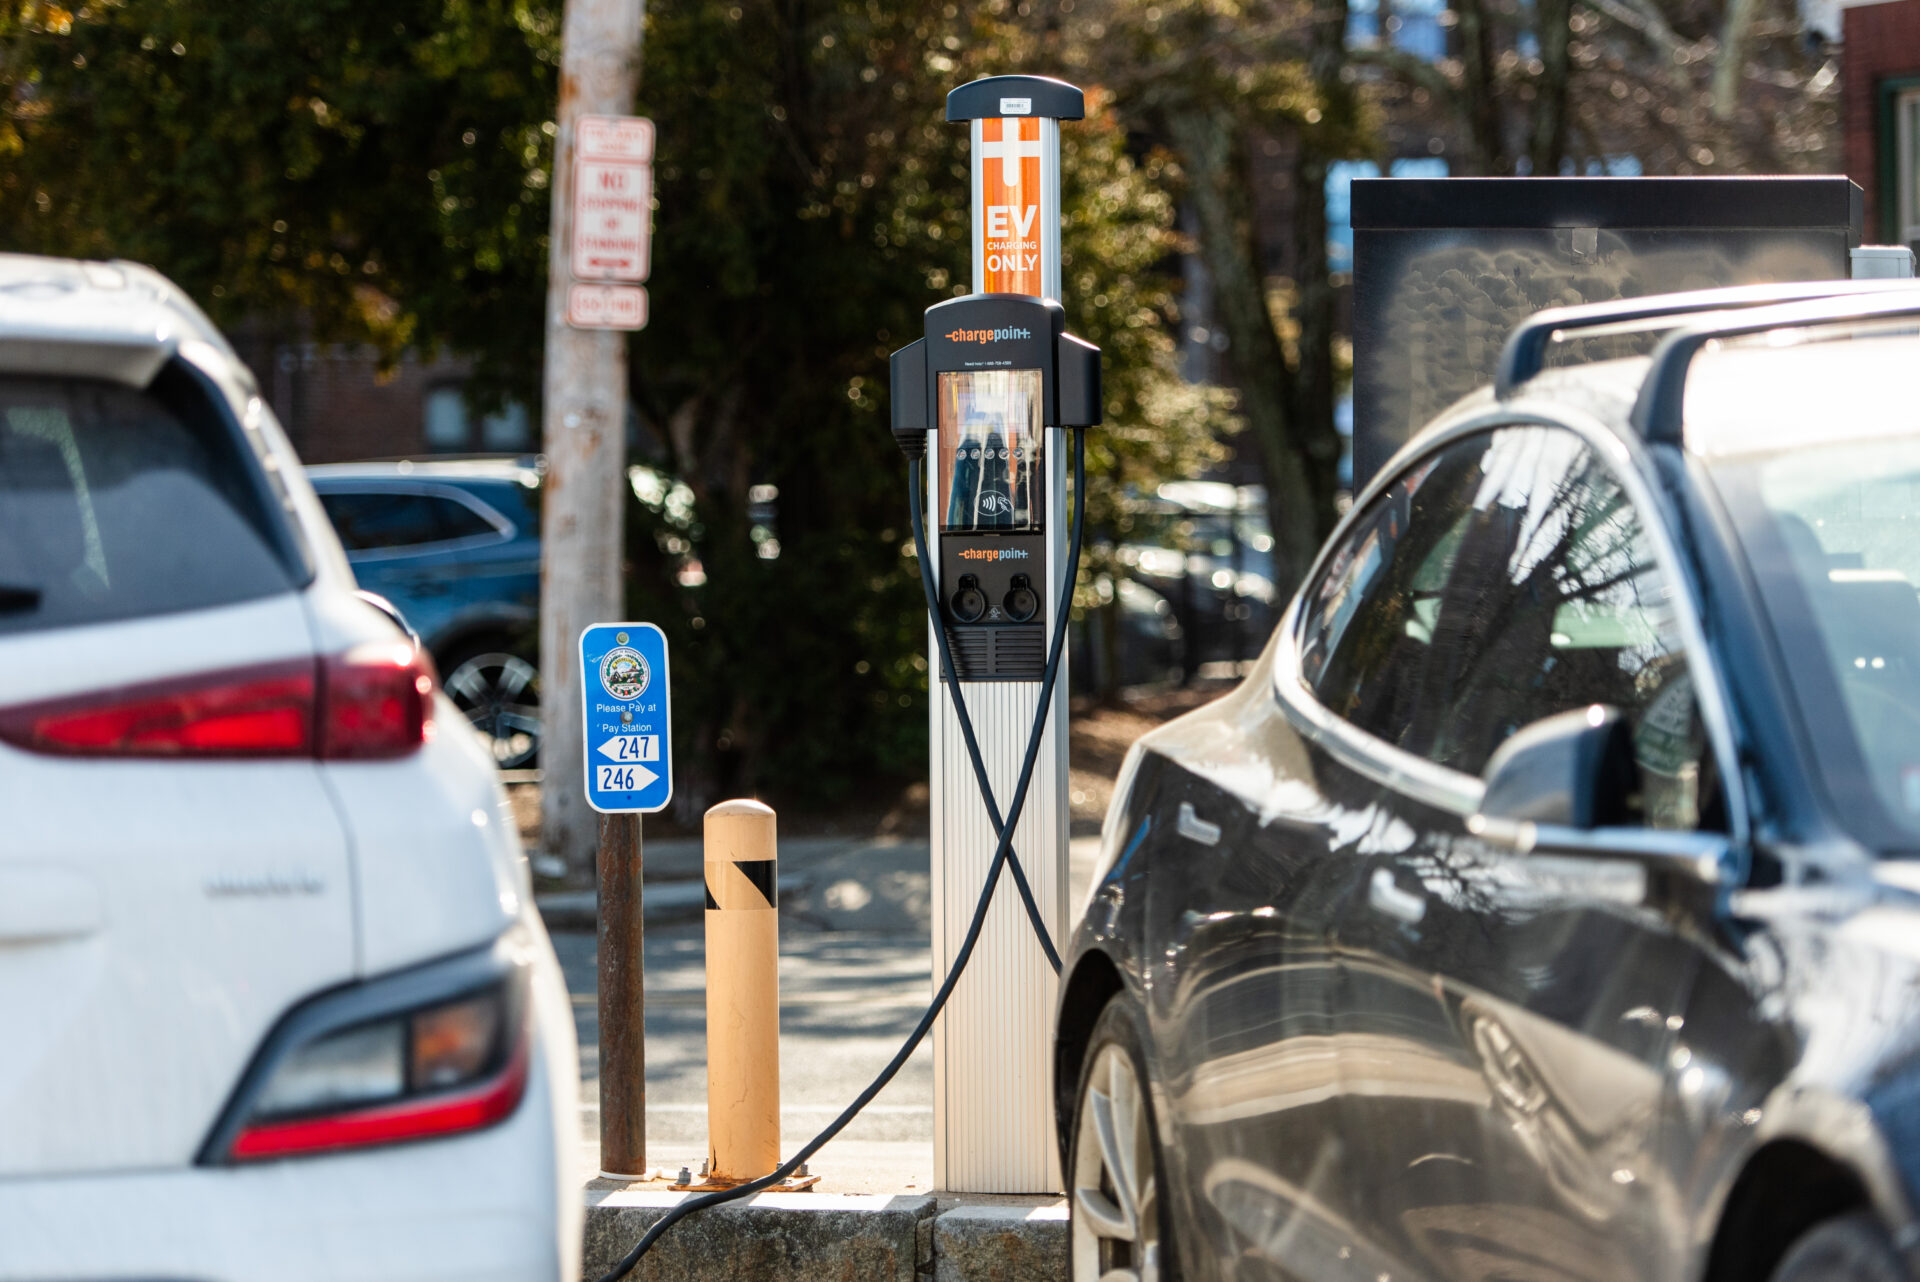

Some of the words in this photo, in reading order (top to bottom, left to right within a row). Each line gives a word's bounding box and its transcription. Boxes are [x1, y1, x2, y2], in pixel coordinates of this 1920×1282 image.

[987, 205, 1038, 238] EV
[987, 241, 1037, 250] CHARGING
[987, 254, 1039, 272] ONLY
[596, 703, 626, 713] Please
[628, 703, 645, 714] Pay
[647, 703, 657, 712] at
[602, 723, 619, 734] Pay
[621, 723, 652, 733] Station
[618, 736, 649, 759] 247
[603, 768, 634, 790] 246
